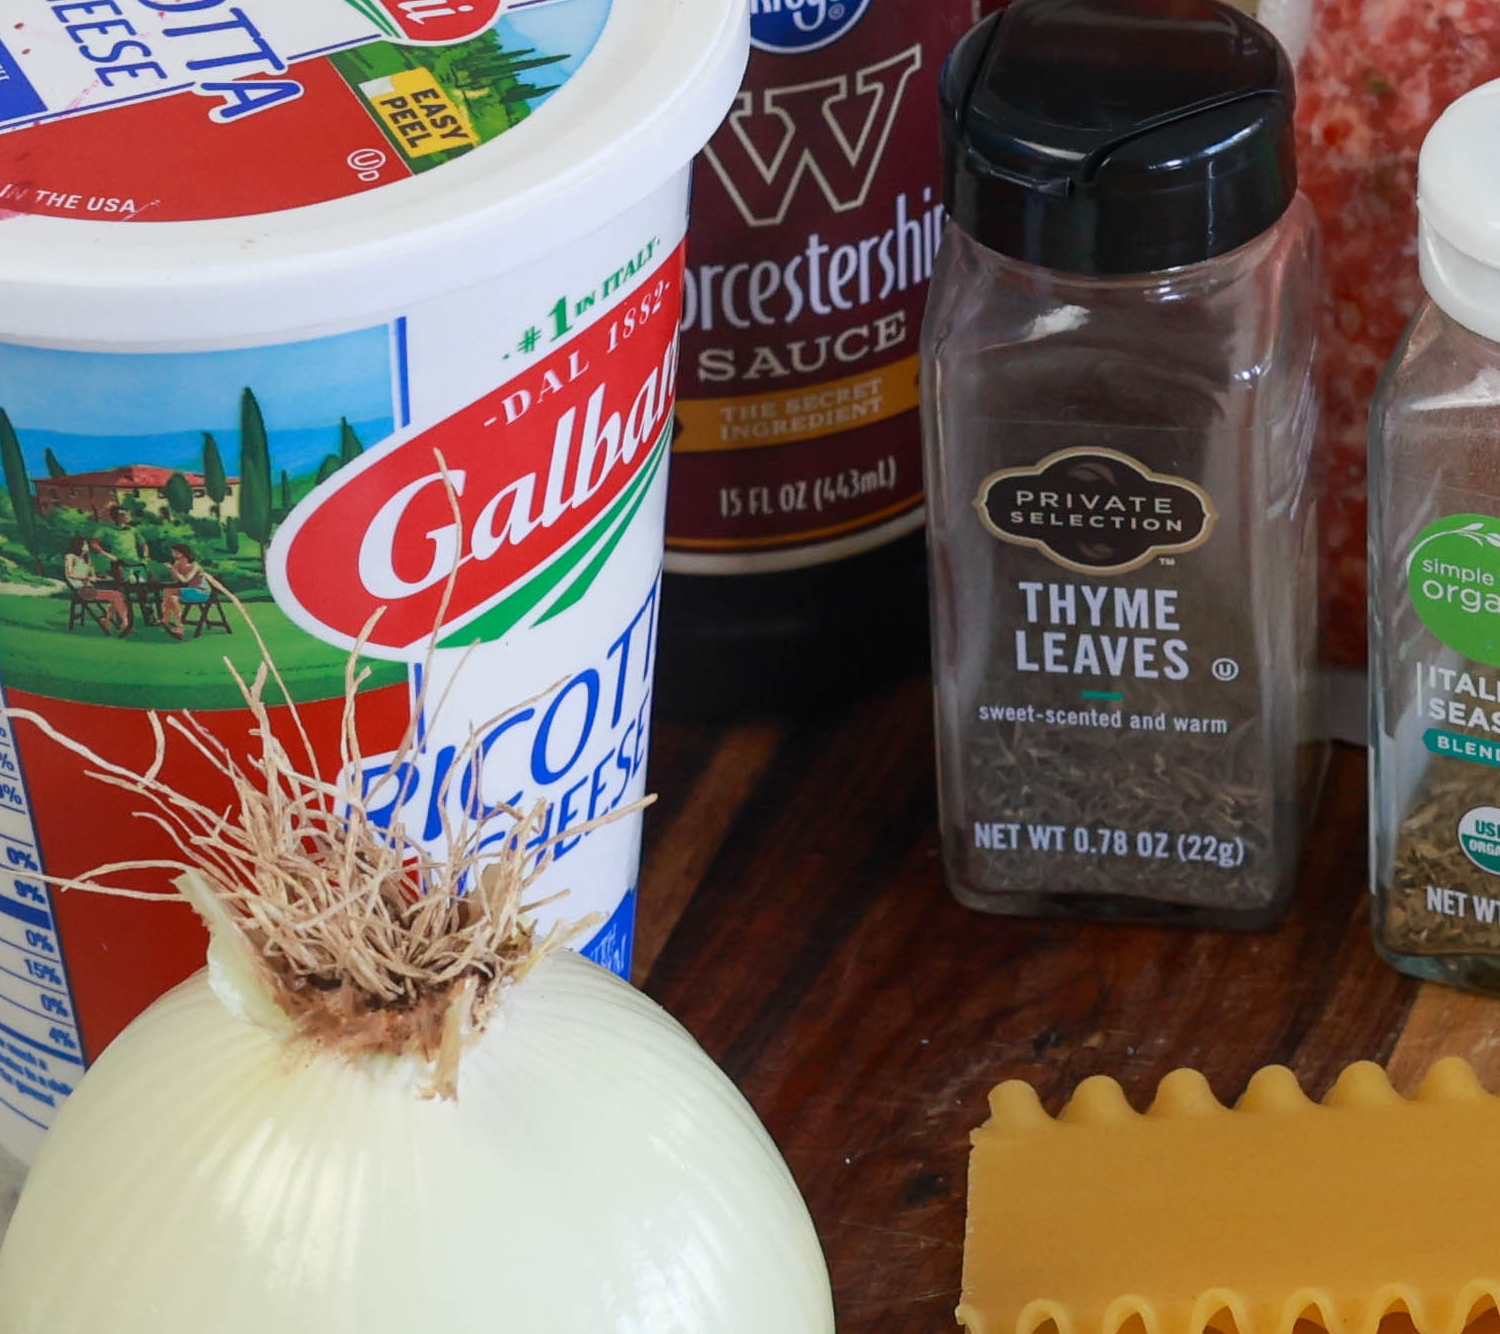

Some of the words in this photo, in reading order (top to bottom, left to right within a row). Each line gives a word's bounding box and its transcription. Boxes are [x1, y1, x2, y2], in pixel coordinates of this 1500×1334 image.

[379, 95, 433, 149] PEEL
[411, 87, 469, 140] EASY
[34, 189, 83, 211] THE
[87, 195, 137, 214] USA
[680, 186, 946, 333] orcestershir
[574, 290, 597, 318] IN
[698, 309, 907, 382] SAUCE
[720, 401, 779, 424] THE
[785, 376, 884, 415] SECRET
[720, 395, 884, 442] INGREDIENT
[357, 318, 680, 601] Galban
[719, 488, 743, 518] 15
[749, 484, 775, 515] FL
[778, 480, 809, 511] OZ
[812, 456, 897, 513] (443mL)
[1016, 489, 1174, 515] PRIVATE
[1010, 510, 1184, 533] SELECTION
[1421, 557, 1495, 588] simple
[1018, 581, 1181, 632] THYME
[1014, 629, 1190, 680] LEAVES
[345, 561, 664, 850] RICOTT
[978, 703, 1123, 729] sweet-scented
[1129, 711, 1167, 733] and
[1172, 715, 1229, 735] warm
[973, 820, 1021, 851] NET
[1028, 823, 1067, 853] WT
[1073, 826, 1127, 857] 0.78
[1135, 830, 1171, 860] OZ
[1176, 831, 1246, 869] (22g)
[1426, 884, 1468, 919] NET
